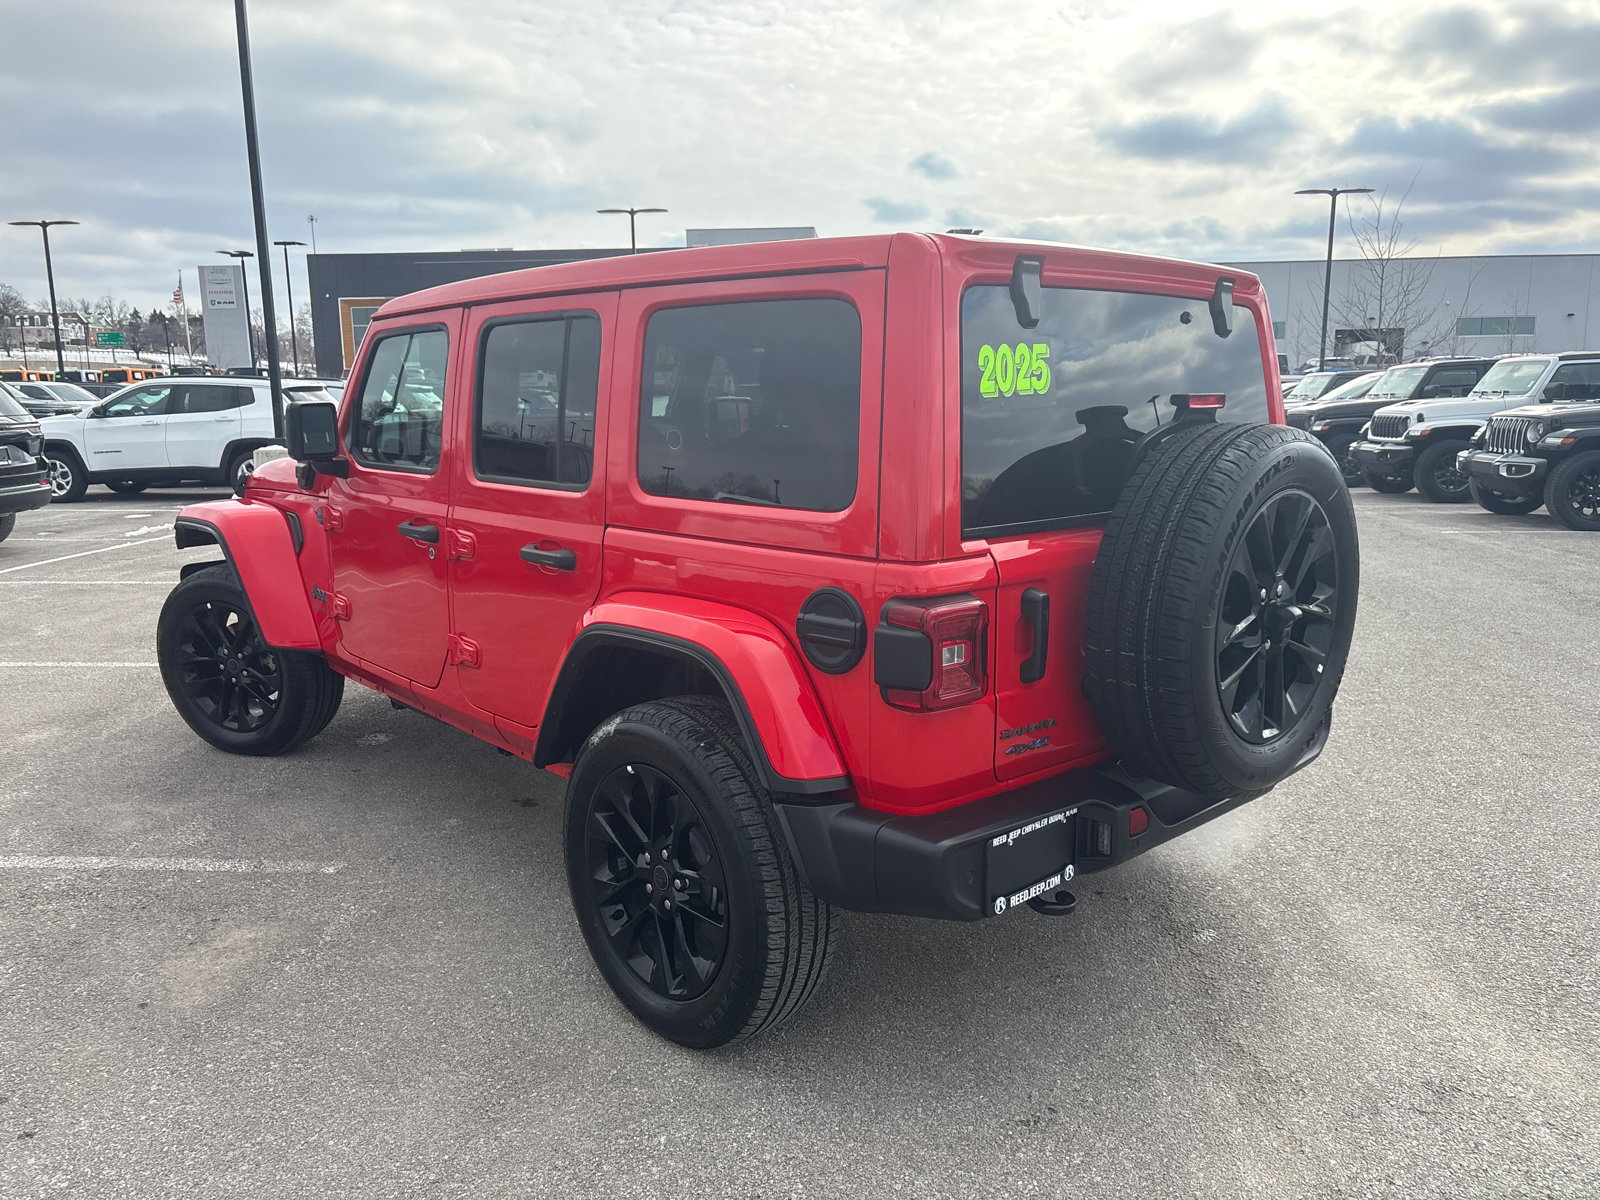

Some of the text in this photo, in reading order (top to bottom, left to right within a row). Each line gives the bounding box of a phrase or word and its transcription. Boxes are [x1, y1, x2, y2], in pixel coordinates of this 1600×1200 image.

[209, 266, 229, 276] Jeep
[978, 342, 1051, 398] 2025
[1000, 718, 1057, 740] SAHARA
[992, 834, 1007, 847] REED
[1008, 829, 1021, 842] JEEP
[1021, 818, 1048, 835] CHRYSLER
[1010, 874, 1061, 907] REEDJEEP.COM
